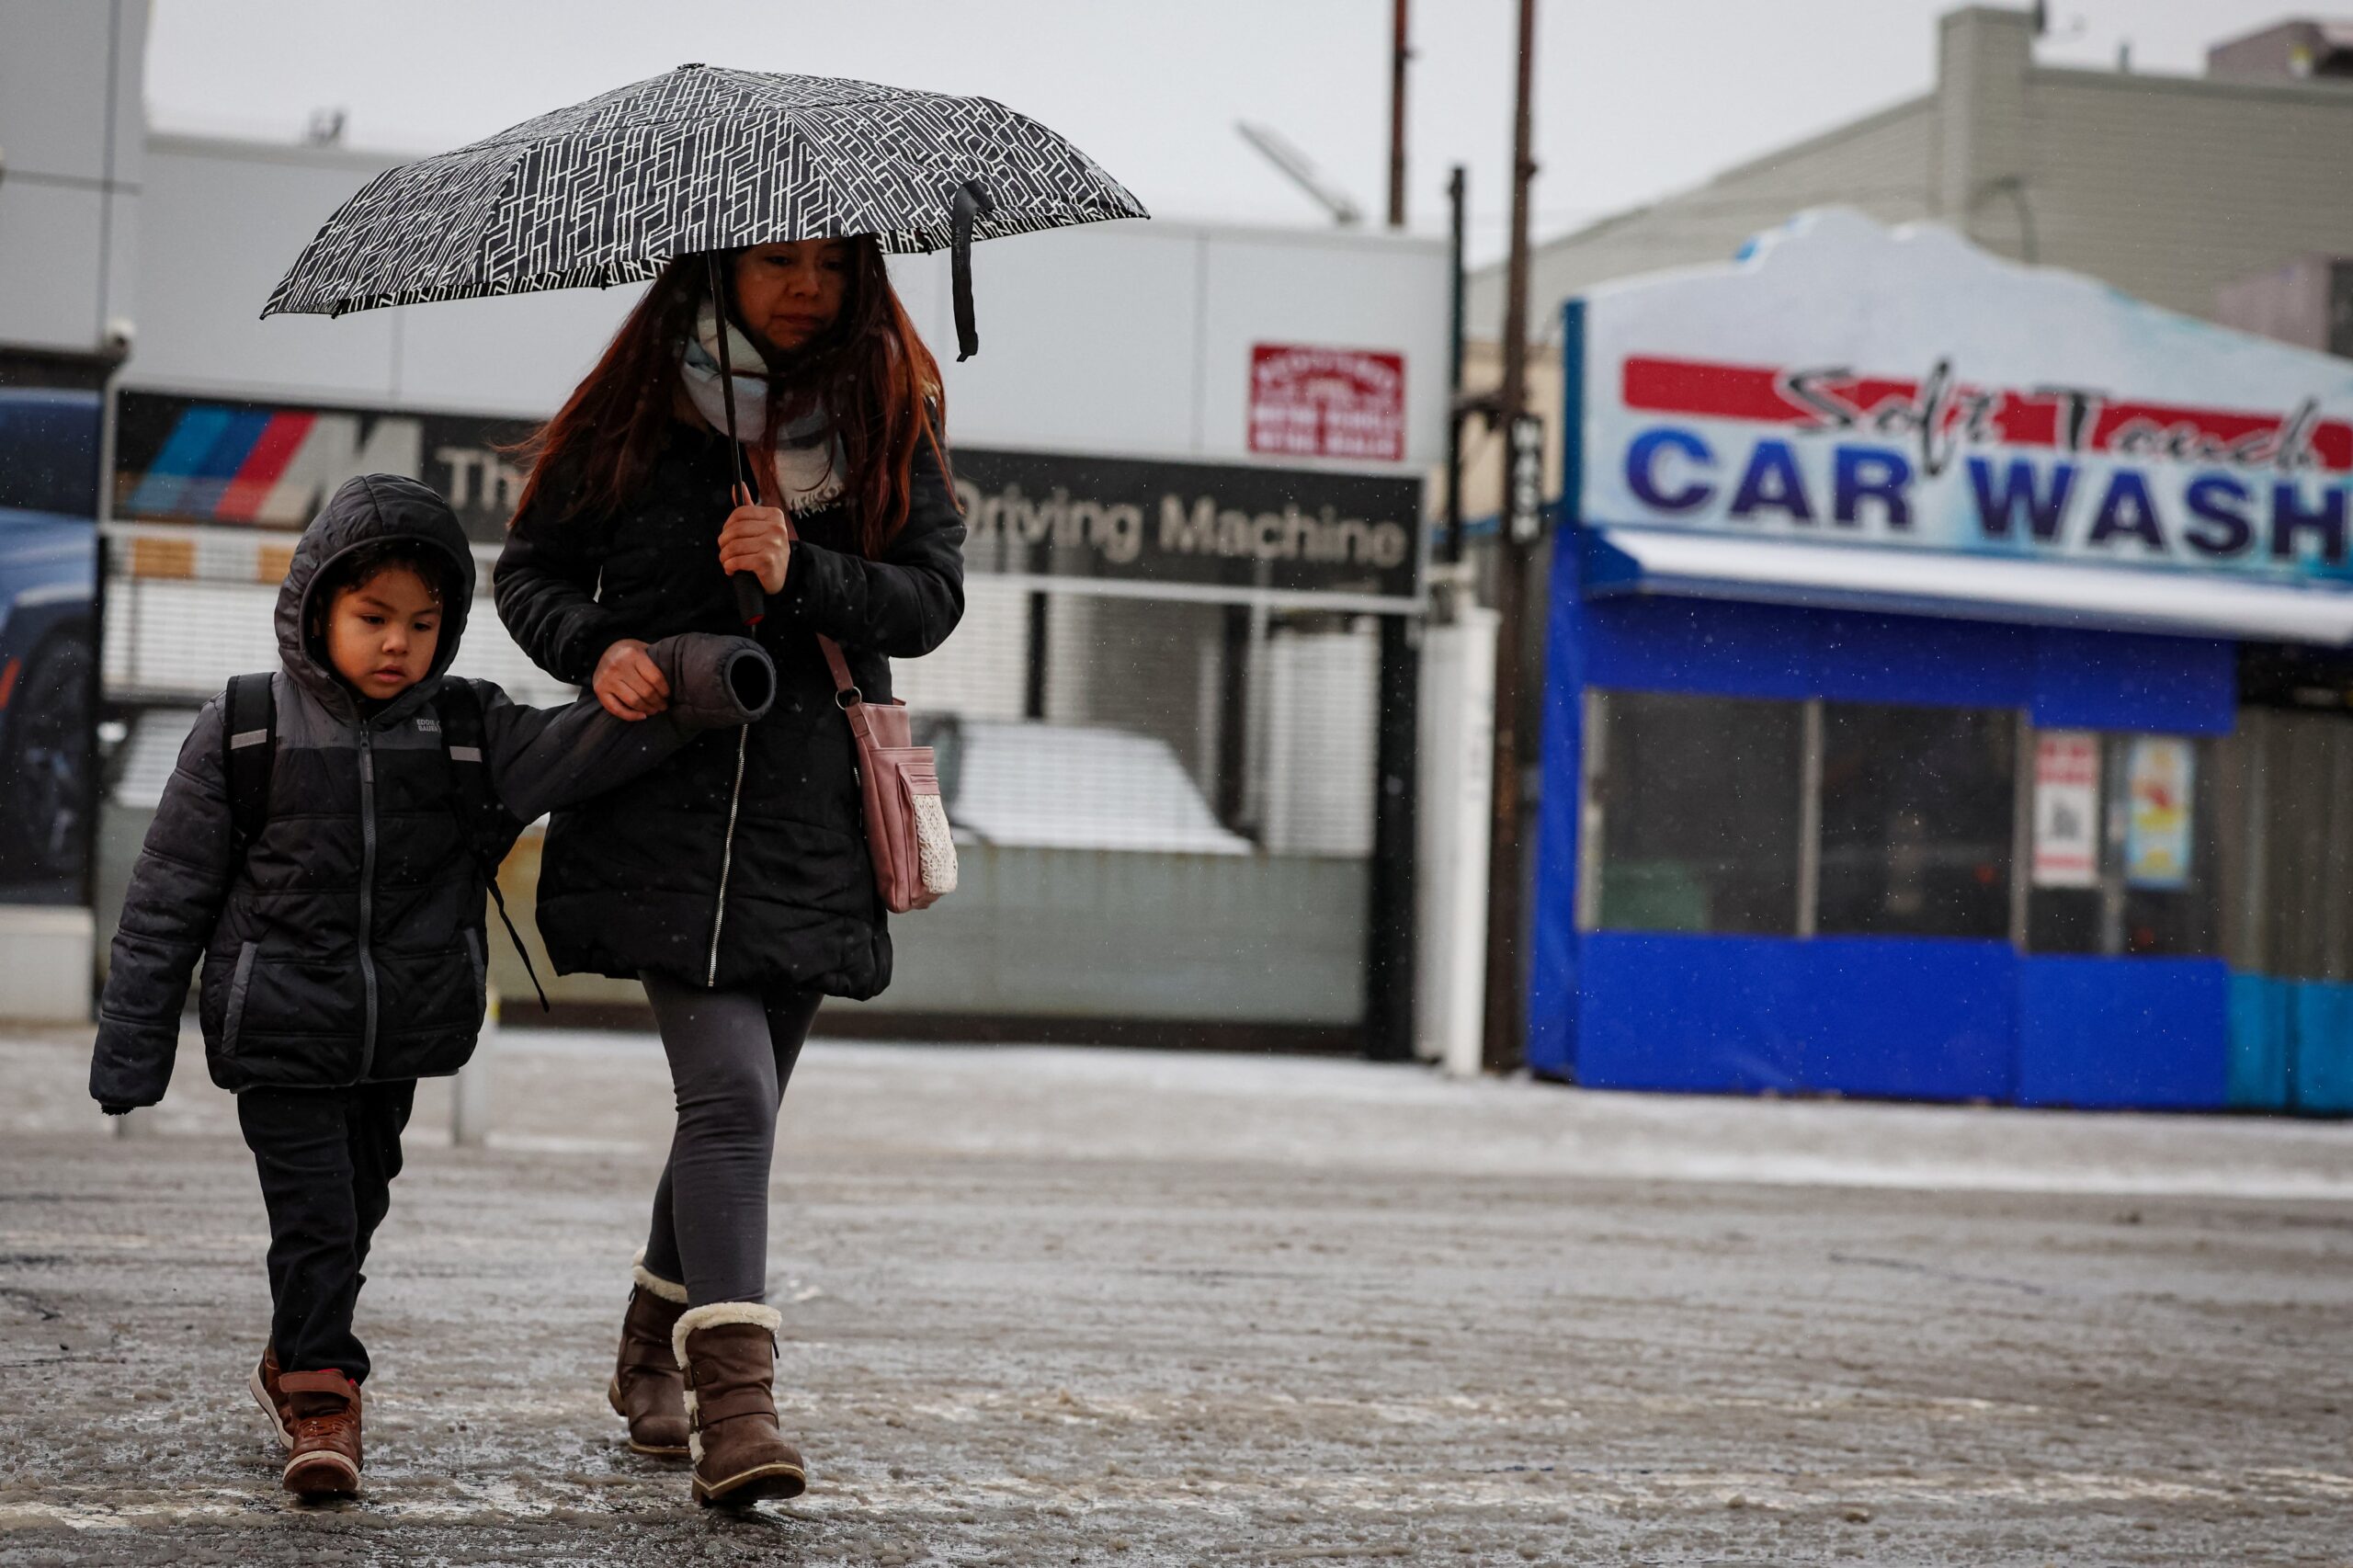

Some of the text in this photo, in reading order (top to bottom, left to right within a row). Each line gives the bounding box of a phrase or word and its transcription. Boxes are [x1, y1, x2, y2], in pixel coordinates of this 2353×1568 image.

[1780, 357, 2324, 478] Soft Touch
[435, 447, 532, 511] Th
[1158, 493, 1407, 569] Machine
[1624, 426, 2350, 566] CAR WASH
